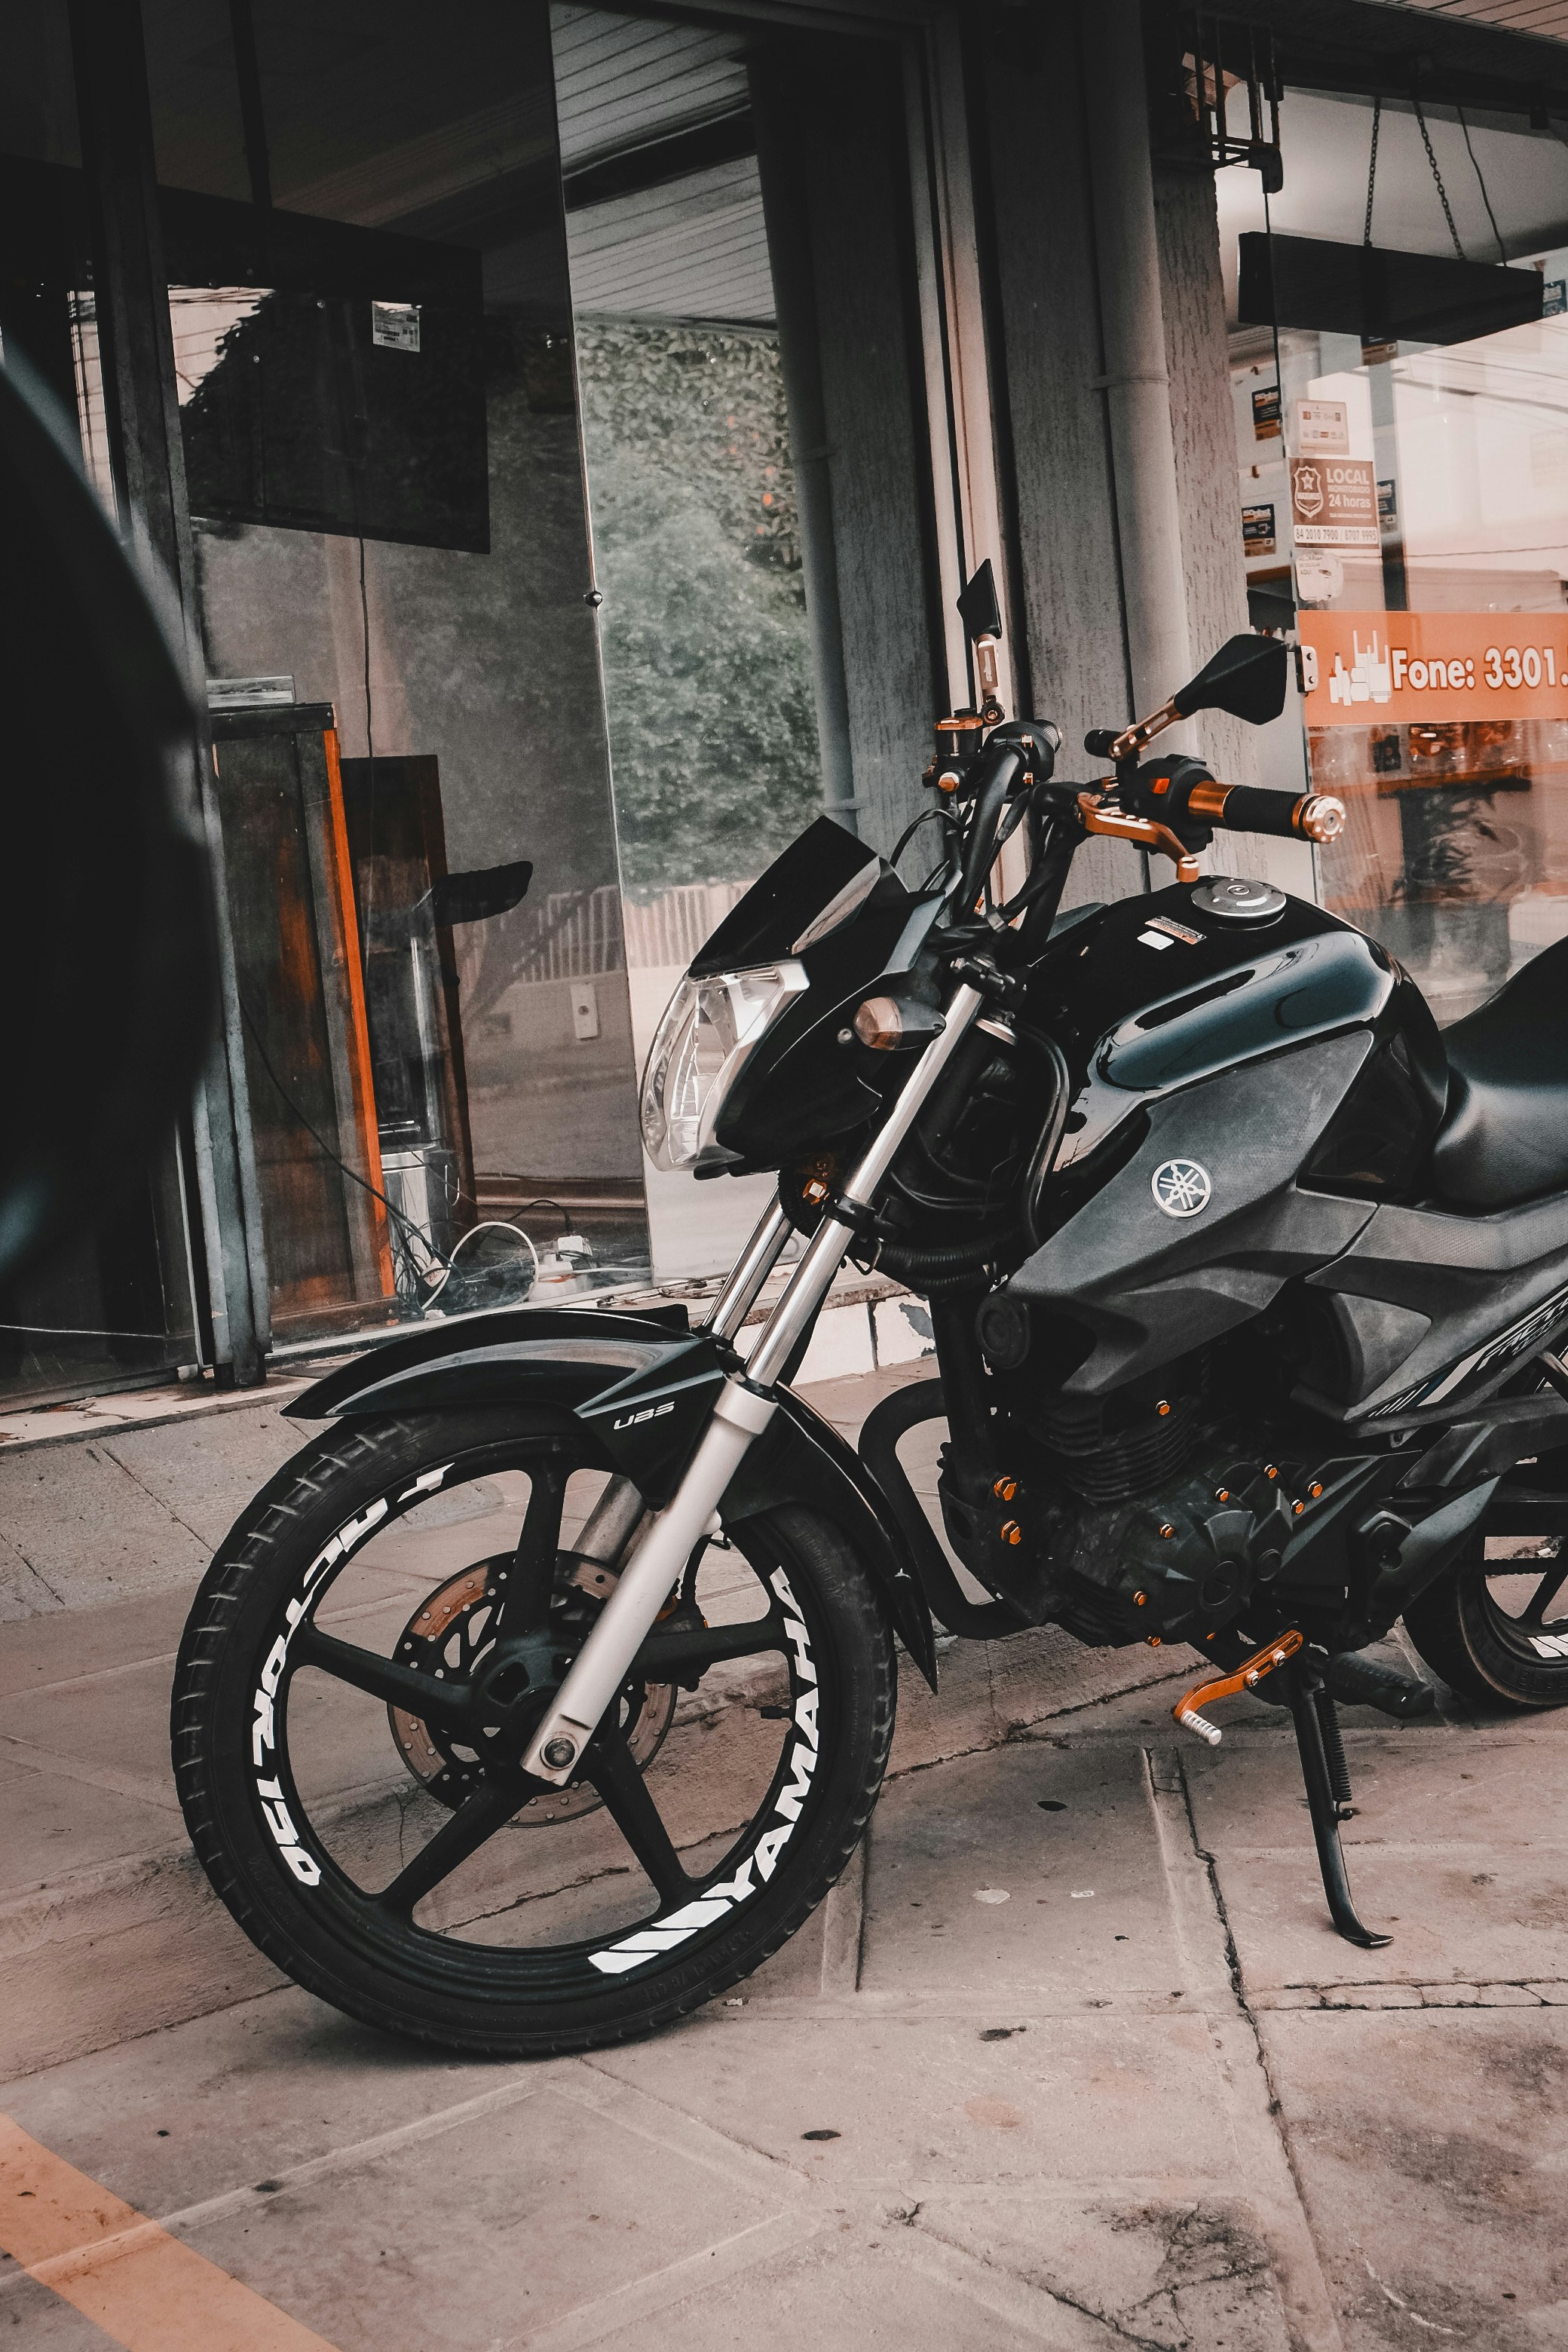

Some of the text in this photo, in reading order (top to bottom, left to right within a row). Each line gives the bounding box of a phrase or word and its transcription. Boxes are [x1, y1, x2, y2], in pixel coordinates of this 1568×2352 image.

[1325, 468, 1370, 485] LOCAL
[1328, 494, 1342, 507] 24
[1343, 495, 1371, 508] horas
[1306, 529, 1321, 540] 2010
[1391, 647, 1475, 690] Fone:
[613, 1401, 675, 1430] UBS
[700, 1565, 820, 1903] YAMAHA
[256, 1775, 322, 1886] 150
